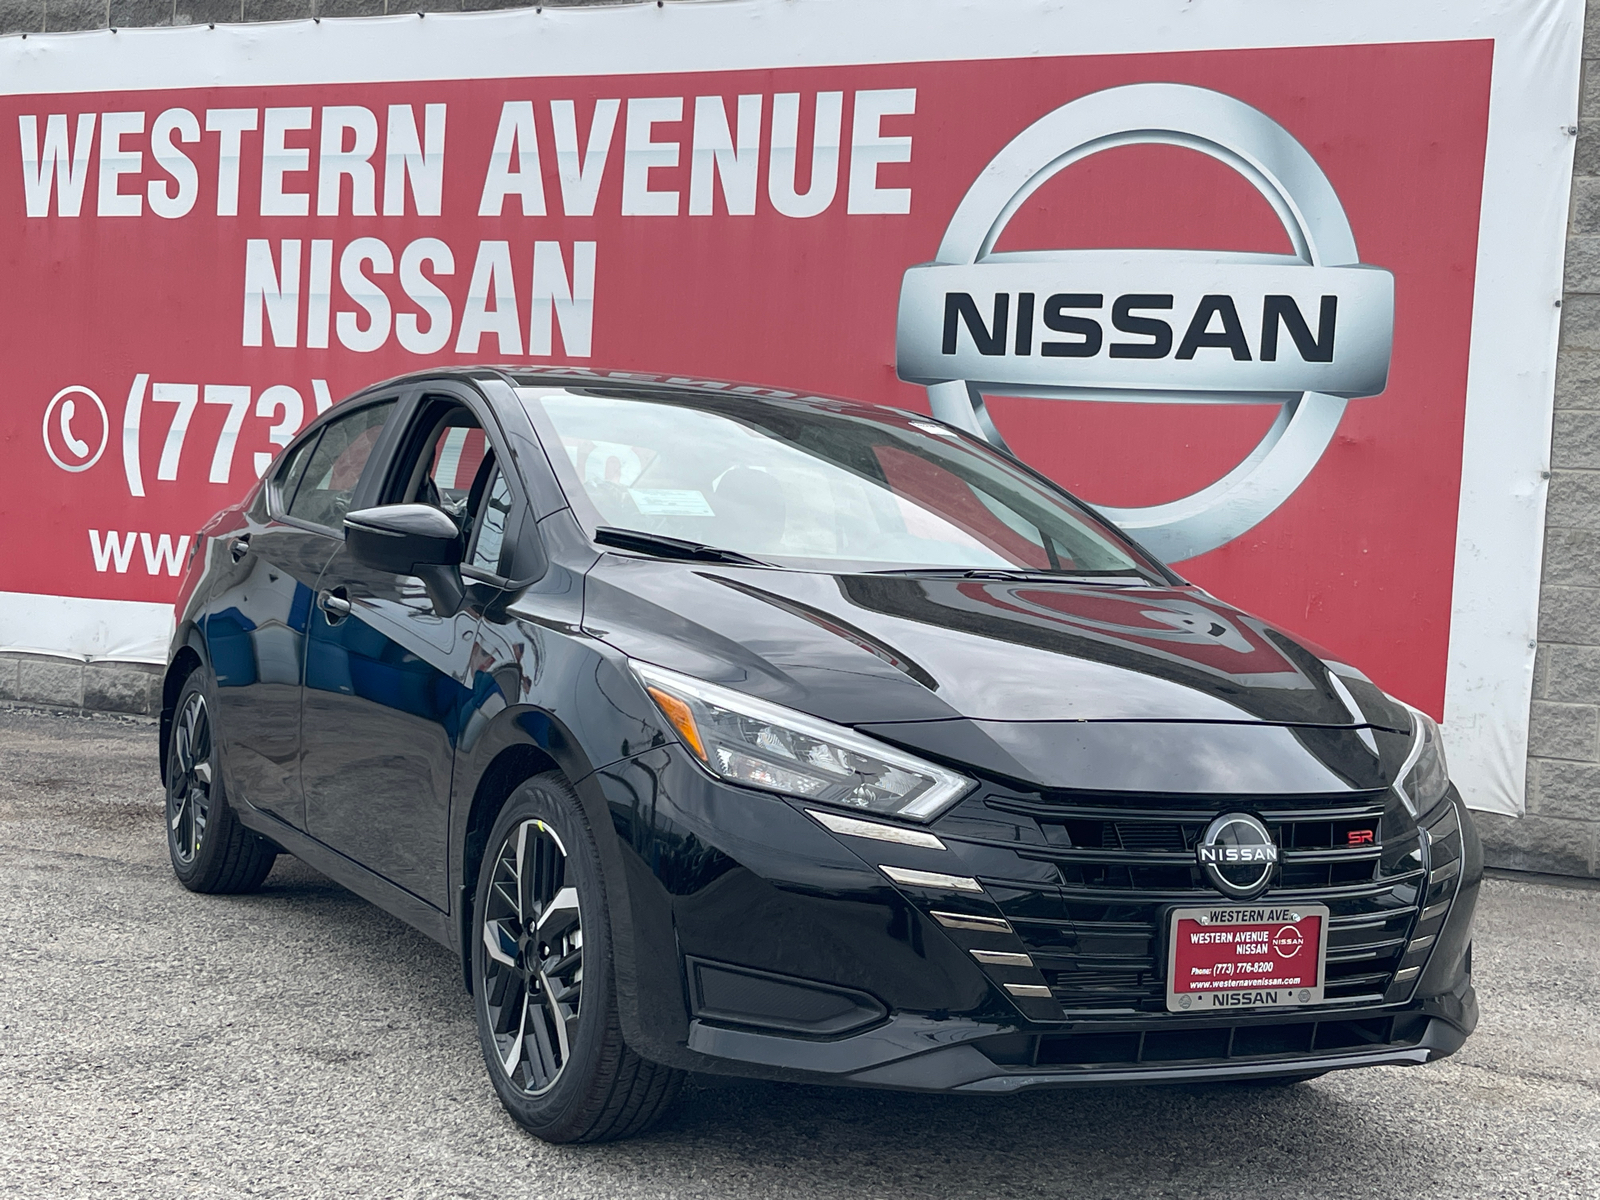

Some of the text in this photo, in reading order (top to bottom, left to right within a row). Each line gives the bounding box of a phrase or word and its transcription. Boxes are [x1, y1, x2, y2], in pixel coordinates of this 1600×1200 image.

[18, 87, 918, 219] WESTERN AVENUE
[242, 236, 597, 358] NISSAN
[940, 292, 1338, 363] NISSAN
[1347, 830, 1373, 844] SR
[1201, 848, 1277, 861] NISSAN
[1210, 910, 1263, 923] WESTERN
[1190, 931, 1269, 944] WESTERN AVENUE
[1236, 944, 1268, 955] NISSAN
[1190, 962, 1274, 977] Phone: (773) 776-8200
[1189, 977, 1301, 989] www.westernavenissan.com
[1212, 991, 1278, 1006] NISSAN
